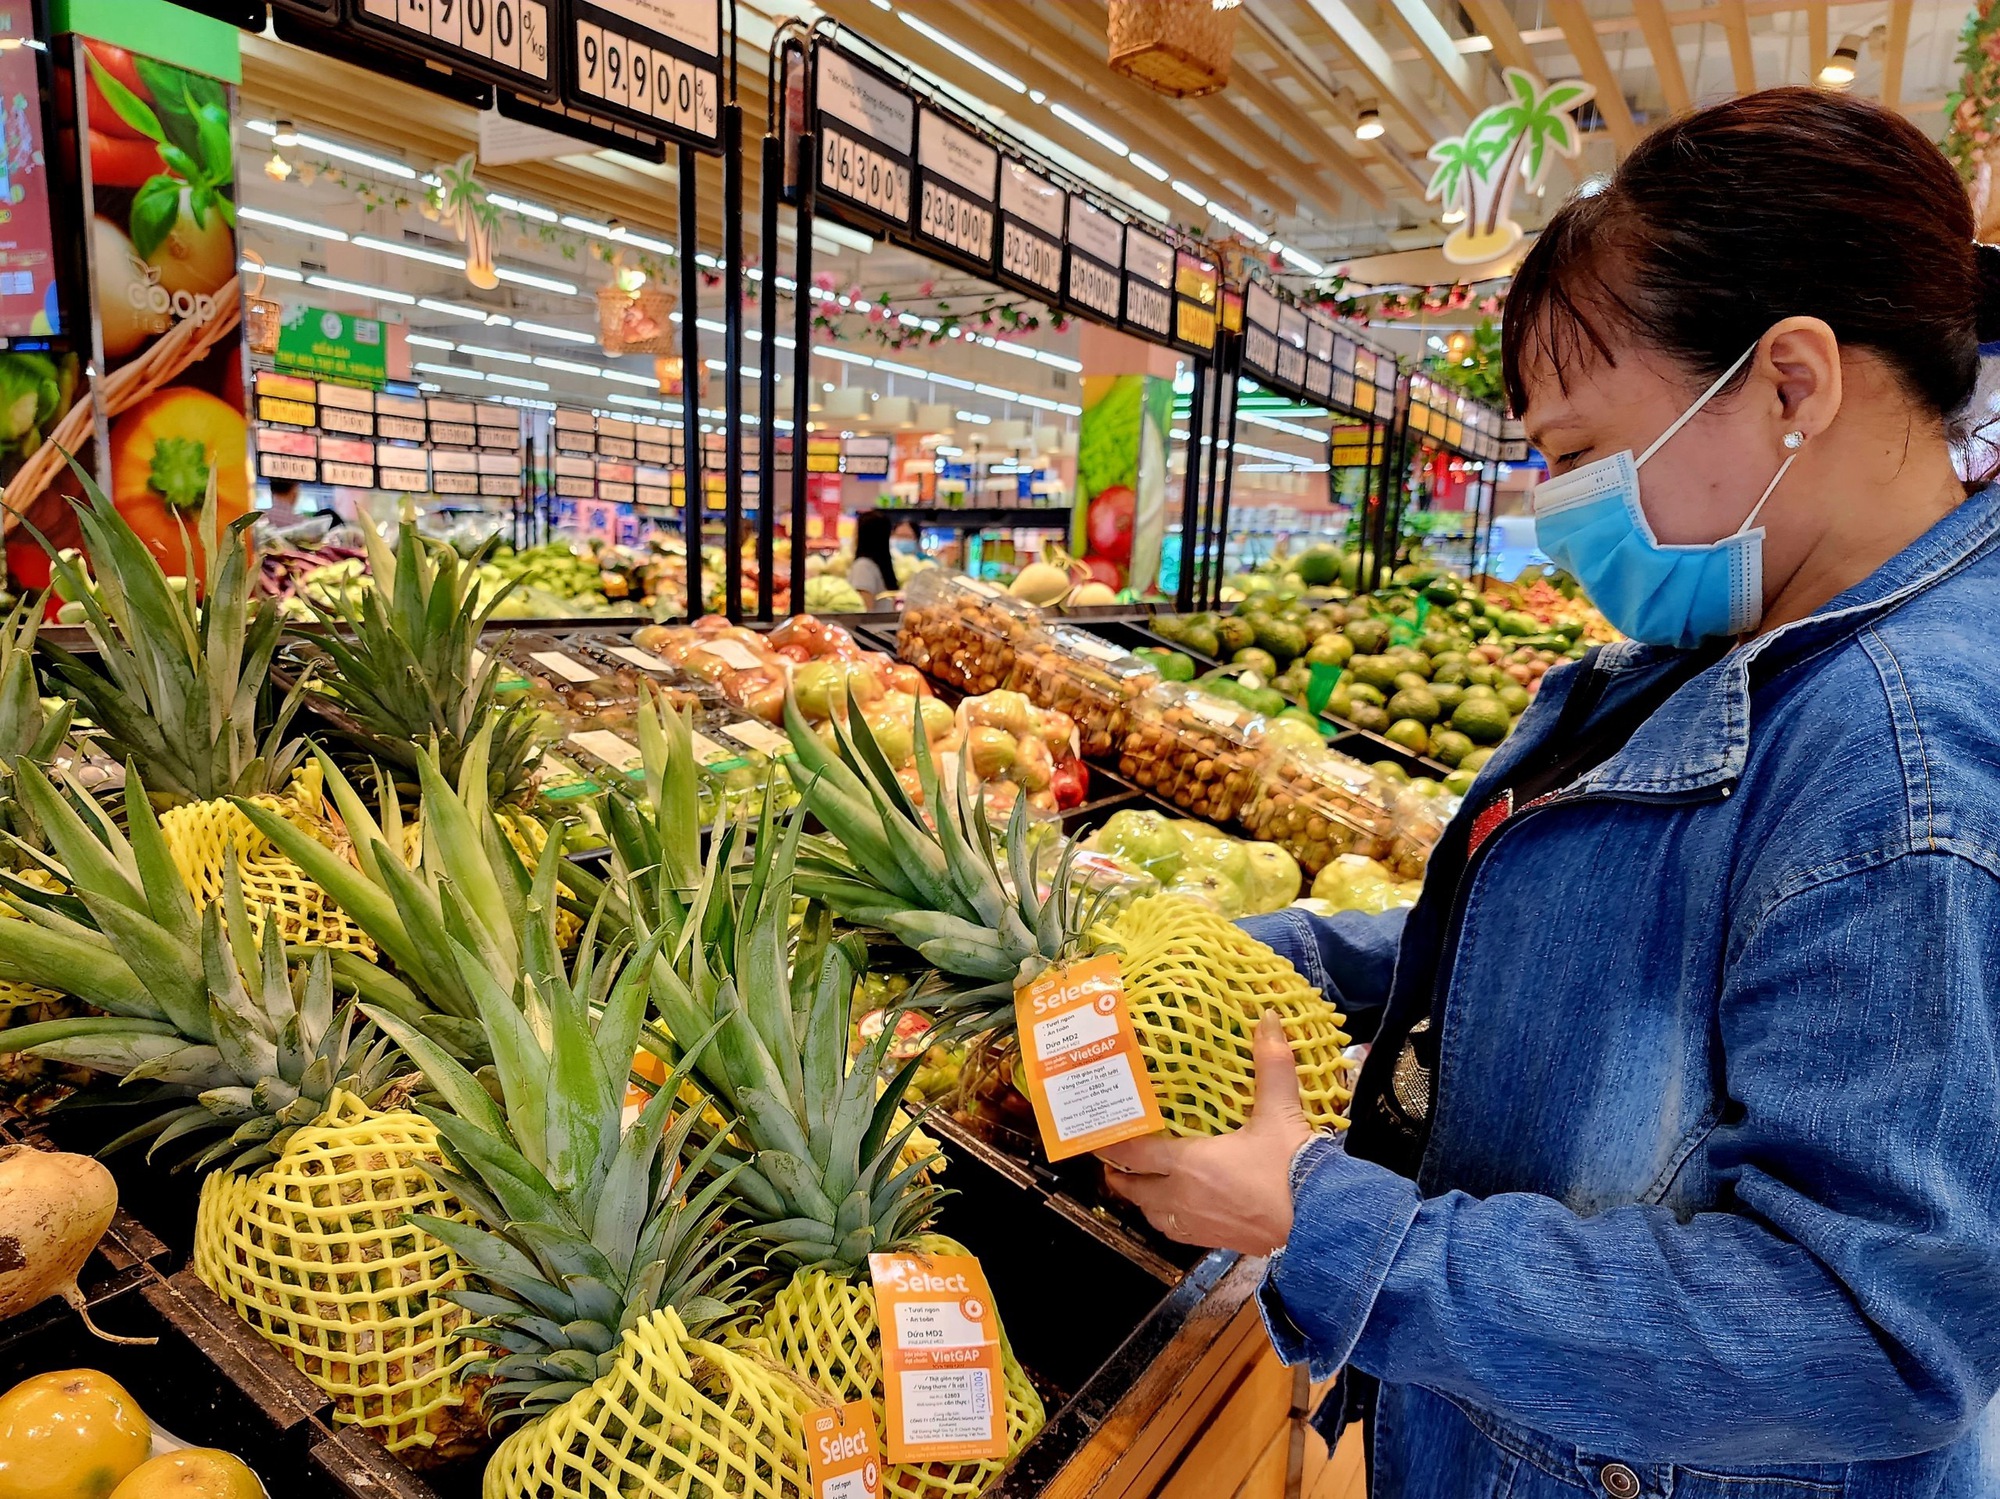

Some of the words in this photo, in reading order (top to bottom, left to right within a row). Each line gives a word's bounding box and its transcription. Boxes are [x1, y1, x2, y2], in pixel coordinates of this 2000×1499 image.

[584, 35, 690, 113] 99.900
[827, 140, 893, 201] 46.300
[925, 191, 978, 242] 23.800
[1033, 975, 1102, 1015] Select
[1062, 1033, 1078, 1043] MD2
[1069, 1038, 1116, 1062] VietGAP
[895, 1272, 970, 1293] Select
[907, 1330, 924, 1338] Dứa
[931, 1350, 979, 1363] VietGAP
[820, 1427, 869, 1465] Select
